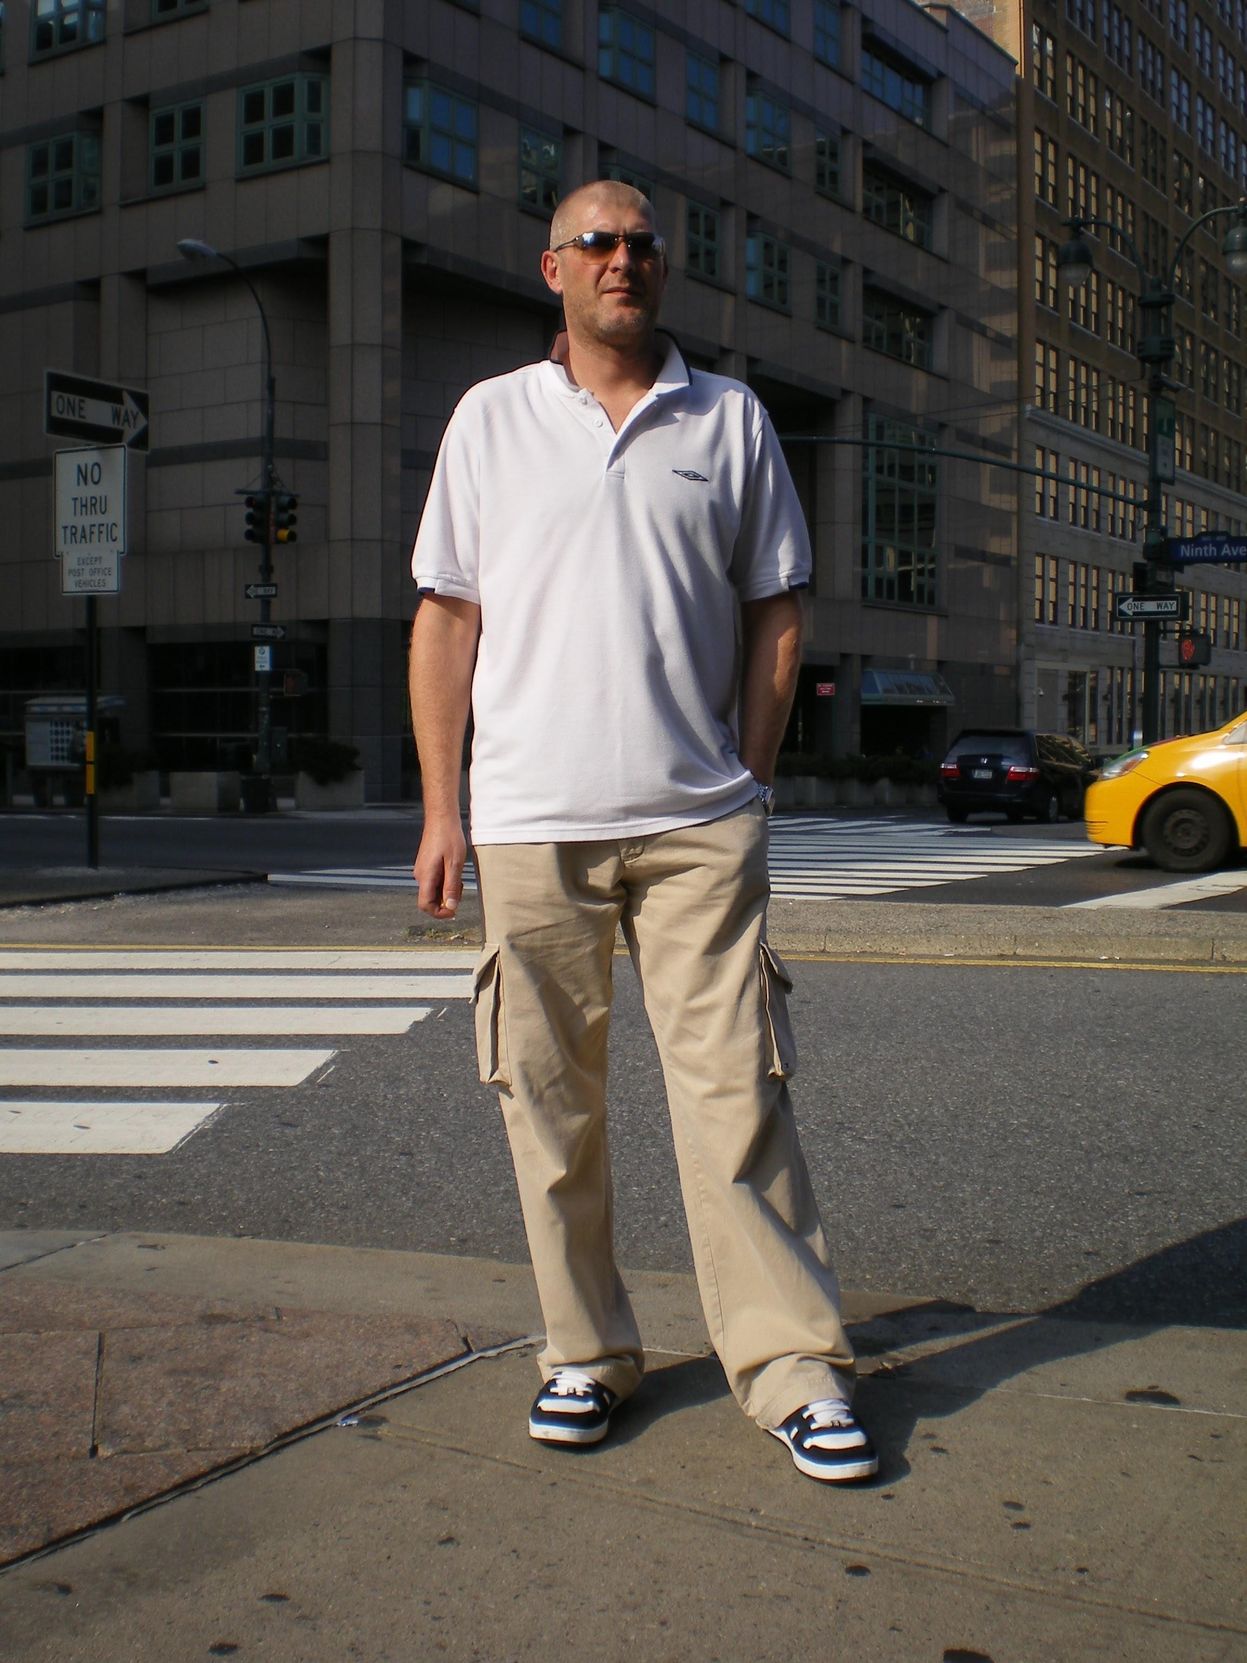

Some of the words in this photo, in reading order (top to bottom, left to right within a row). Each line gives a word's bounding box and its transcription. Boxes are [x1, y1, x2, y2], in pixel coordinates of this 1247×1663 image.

[56, 394, 86, 419] ONE
[111, 406, 140, 429] WAY
[76, 462, 102, 487] NO
[72, 495, 107, 517] THRU
[62, 523, 118, 545] TRAFFIC
[1180, 543, 1217, 557] Ninth
[1221, 543, 1247, 557] Ave
[77, 556, 103, 566] EXCEPT
[68, 567, 85, 577] POST
[88, 567, 112, 577] OFFICE
[74, 578, 106, 588] VEHICLES
[1127, 602, 1144, 611] ONE
[1156, 601, 1176, 610] WAY
